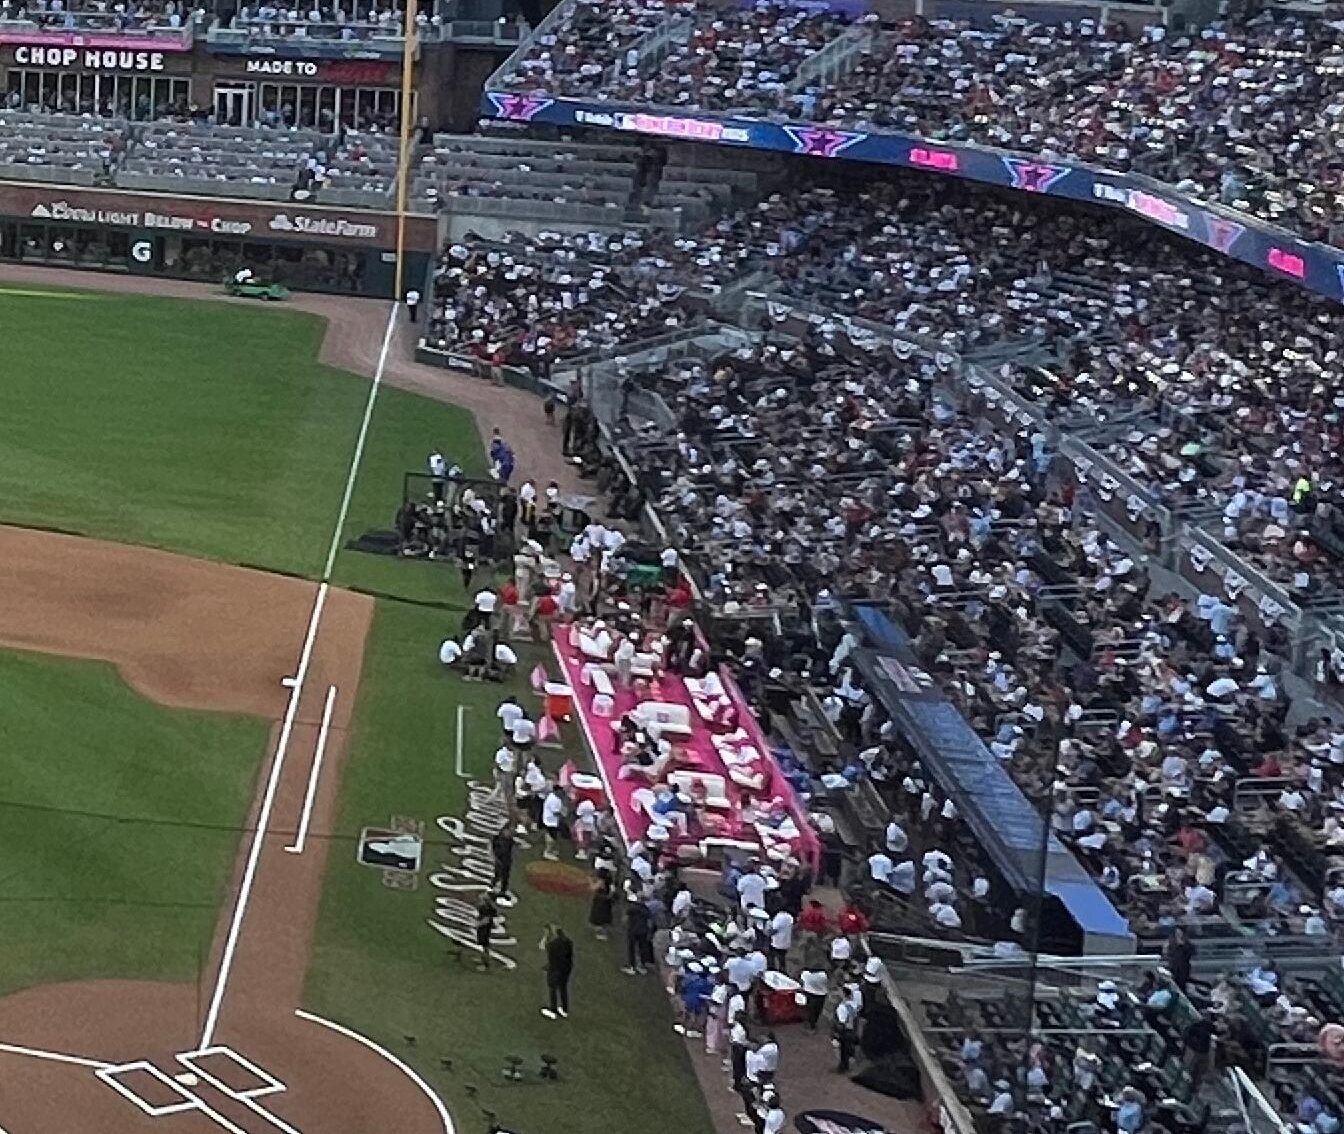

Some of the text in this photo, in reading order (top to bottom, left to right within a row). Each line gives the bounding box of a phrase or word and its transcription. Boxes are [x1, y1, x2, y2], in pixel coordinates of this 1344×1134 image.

[15, 46, 164, 70] CHOP HOUSE
[247, 60, 292, 74] MADE
[296, 62, 318, 76] TO
[132, 241, 152, 261] G
